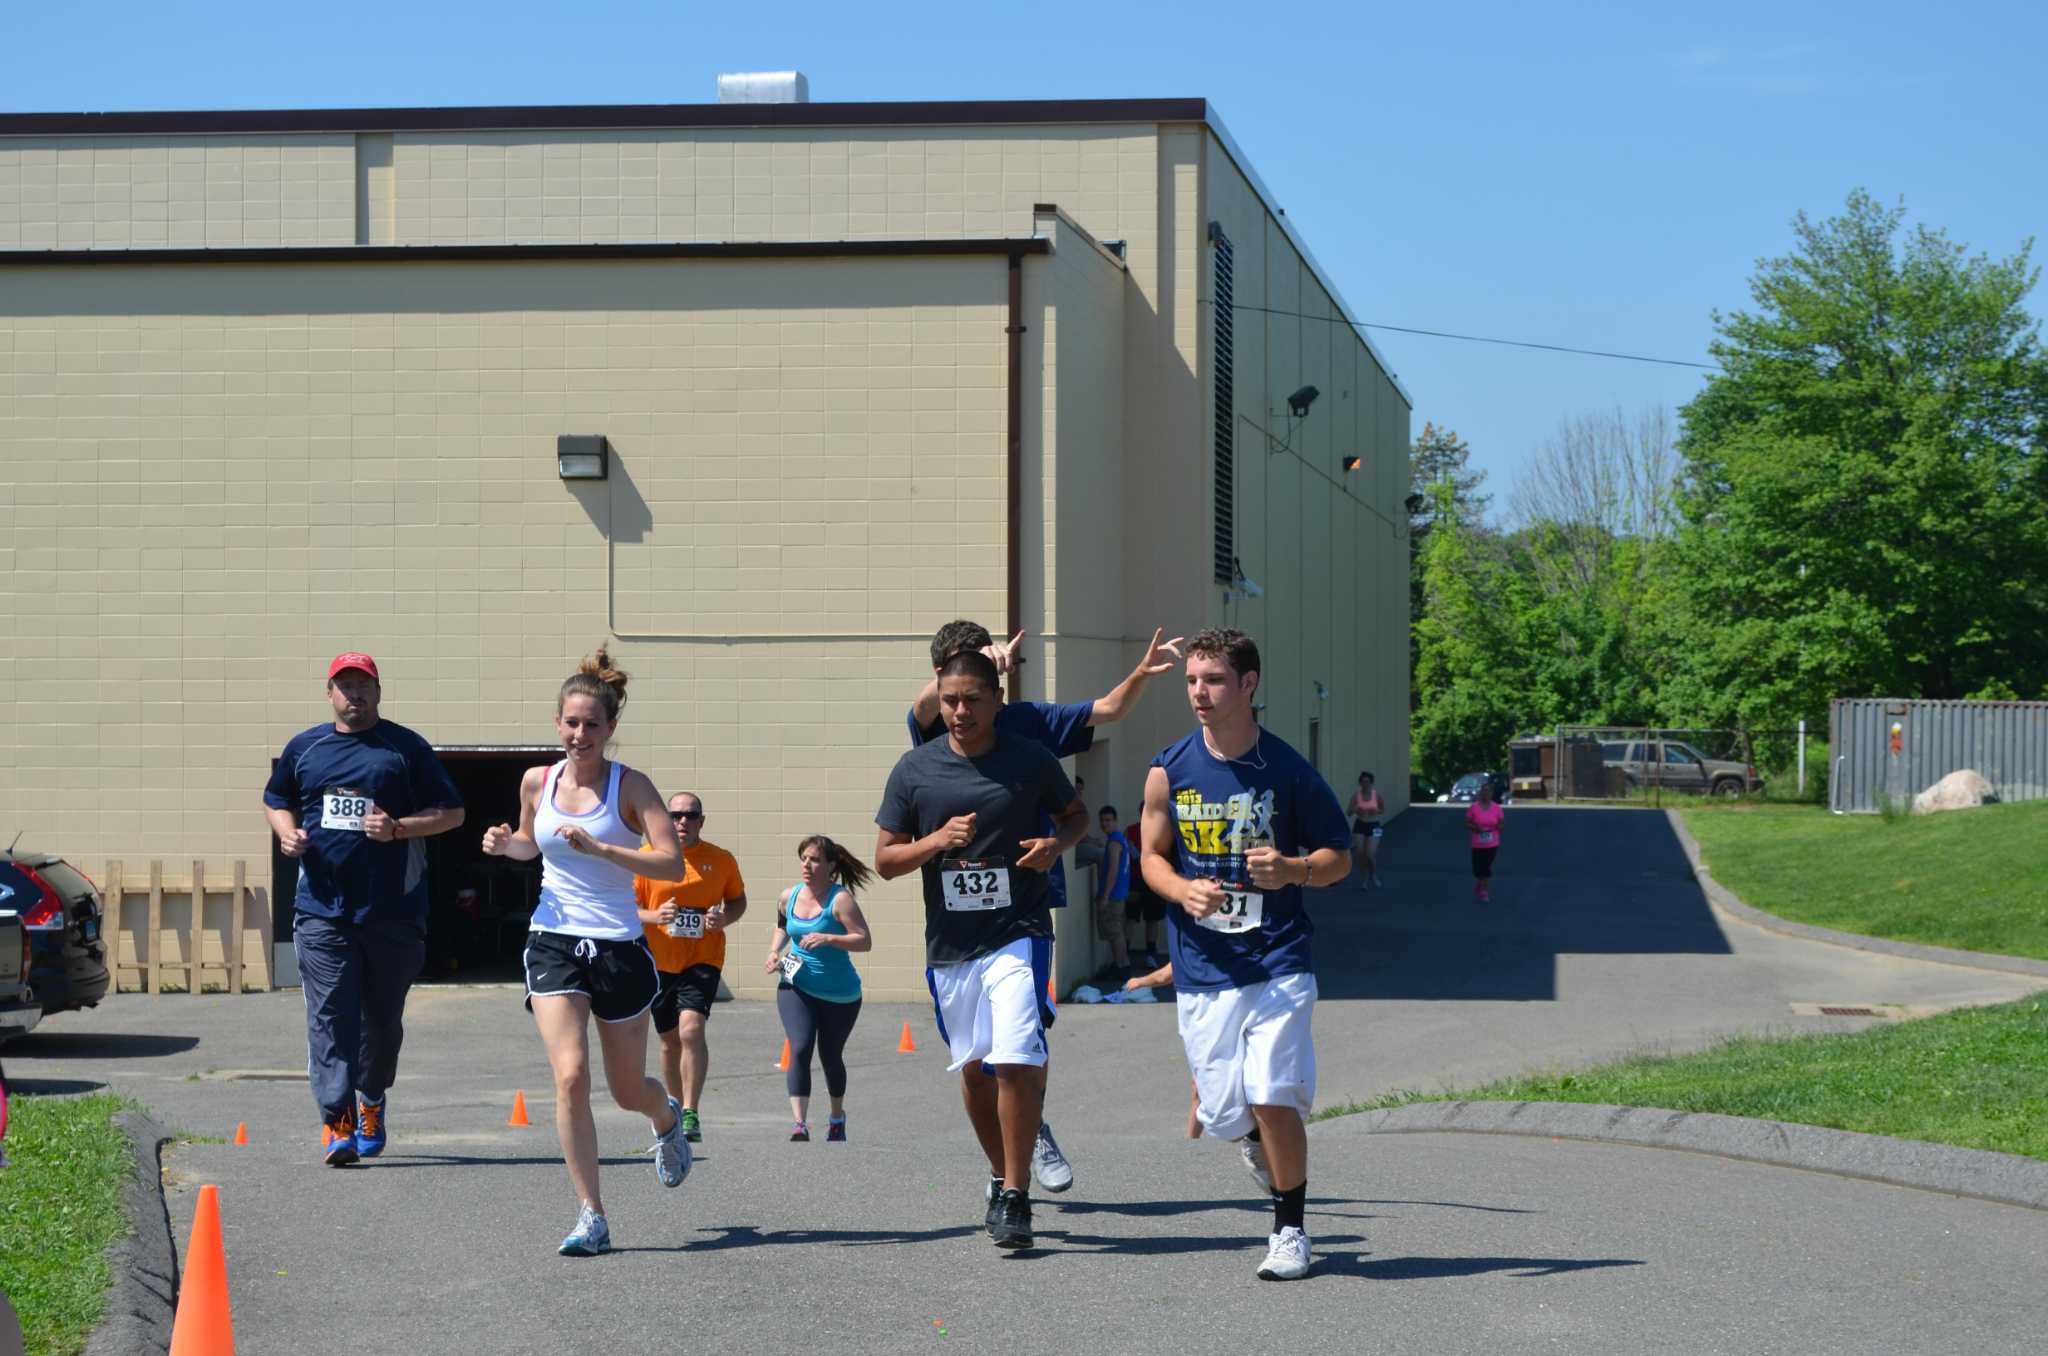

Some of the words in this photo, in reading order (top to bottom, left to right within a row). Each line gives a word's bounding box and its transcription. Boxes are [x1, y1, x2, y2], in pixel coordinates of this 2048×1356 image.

[329, 798, 366, 817] 388
[1178, 820, 1230, 855] 5K
[953, 871, 999, 895] 432
[1219, 893, 1248, 916] 31
[675, 914, 701, 928] 319
